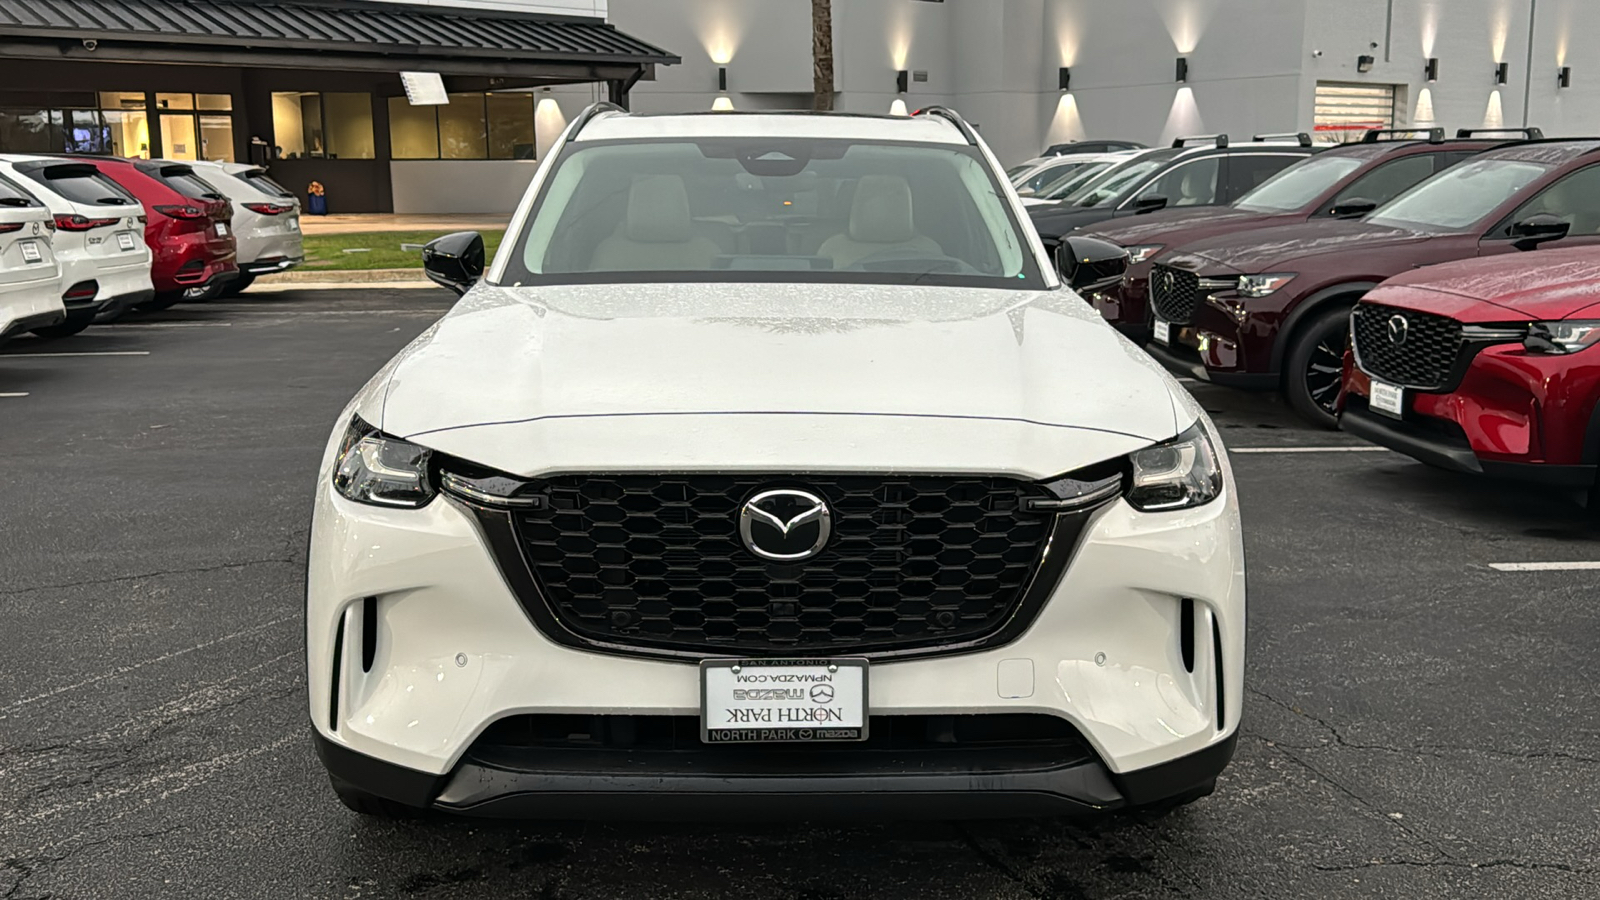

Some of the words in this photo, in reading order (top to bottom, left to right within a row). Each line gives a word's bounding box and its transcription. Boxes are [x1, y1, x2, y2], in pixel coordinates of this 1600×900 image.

[737, 674, 833, 683] NPMAZDA.COM
[733, 688, 804, 700] mazda
[725, 708, 772, 723] PARK
[777, 707, 843, 723] NORTH
[711, 730, 757, 741] NORTH
[761, 729, 796, 740] PARK
[816, 729, 858, 738] mazda
